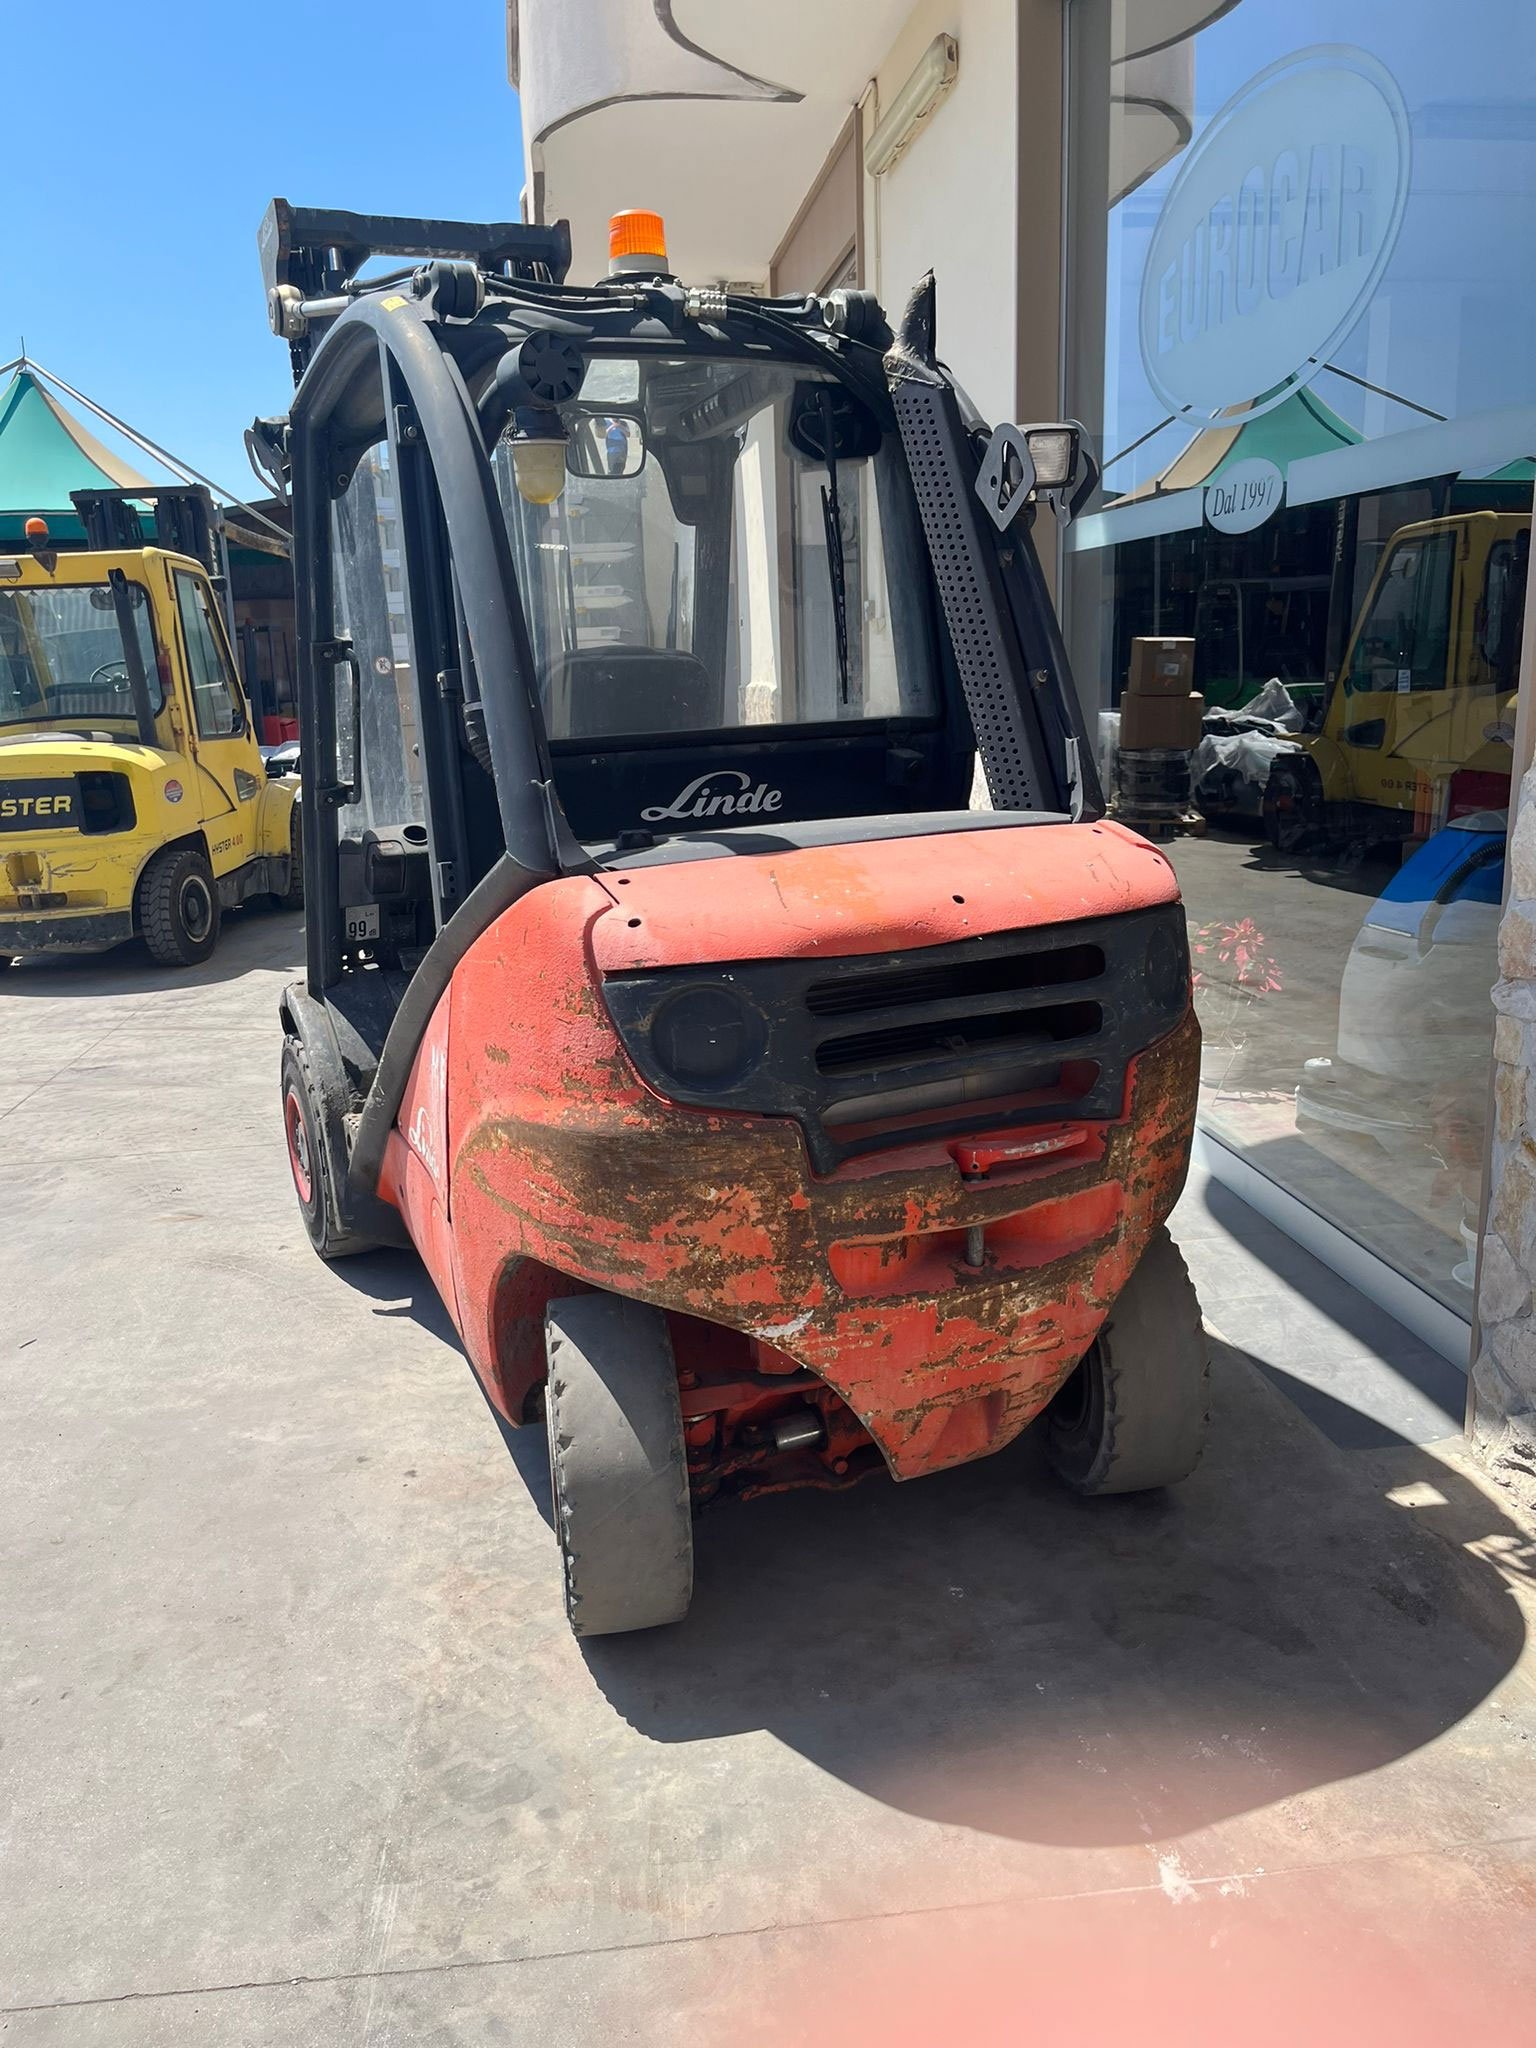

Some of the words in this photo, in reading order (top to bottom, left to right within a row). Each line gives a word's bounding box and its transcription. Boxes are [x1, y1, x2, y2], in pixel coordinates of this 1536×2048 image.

[1158, 144, 1375, 355] EUROCAR
[1213, 484, 1237, 517] Dal
[1241, 475, 1274, 511] 1997
[640, 770, 783, 822] Linde
[349, 920, 367, 938] 99
